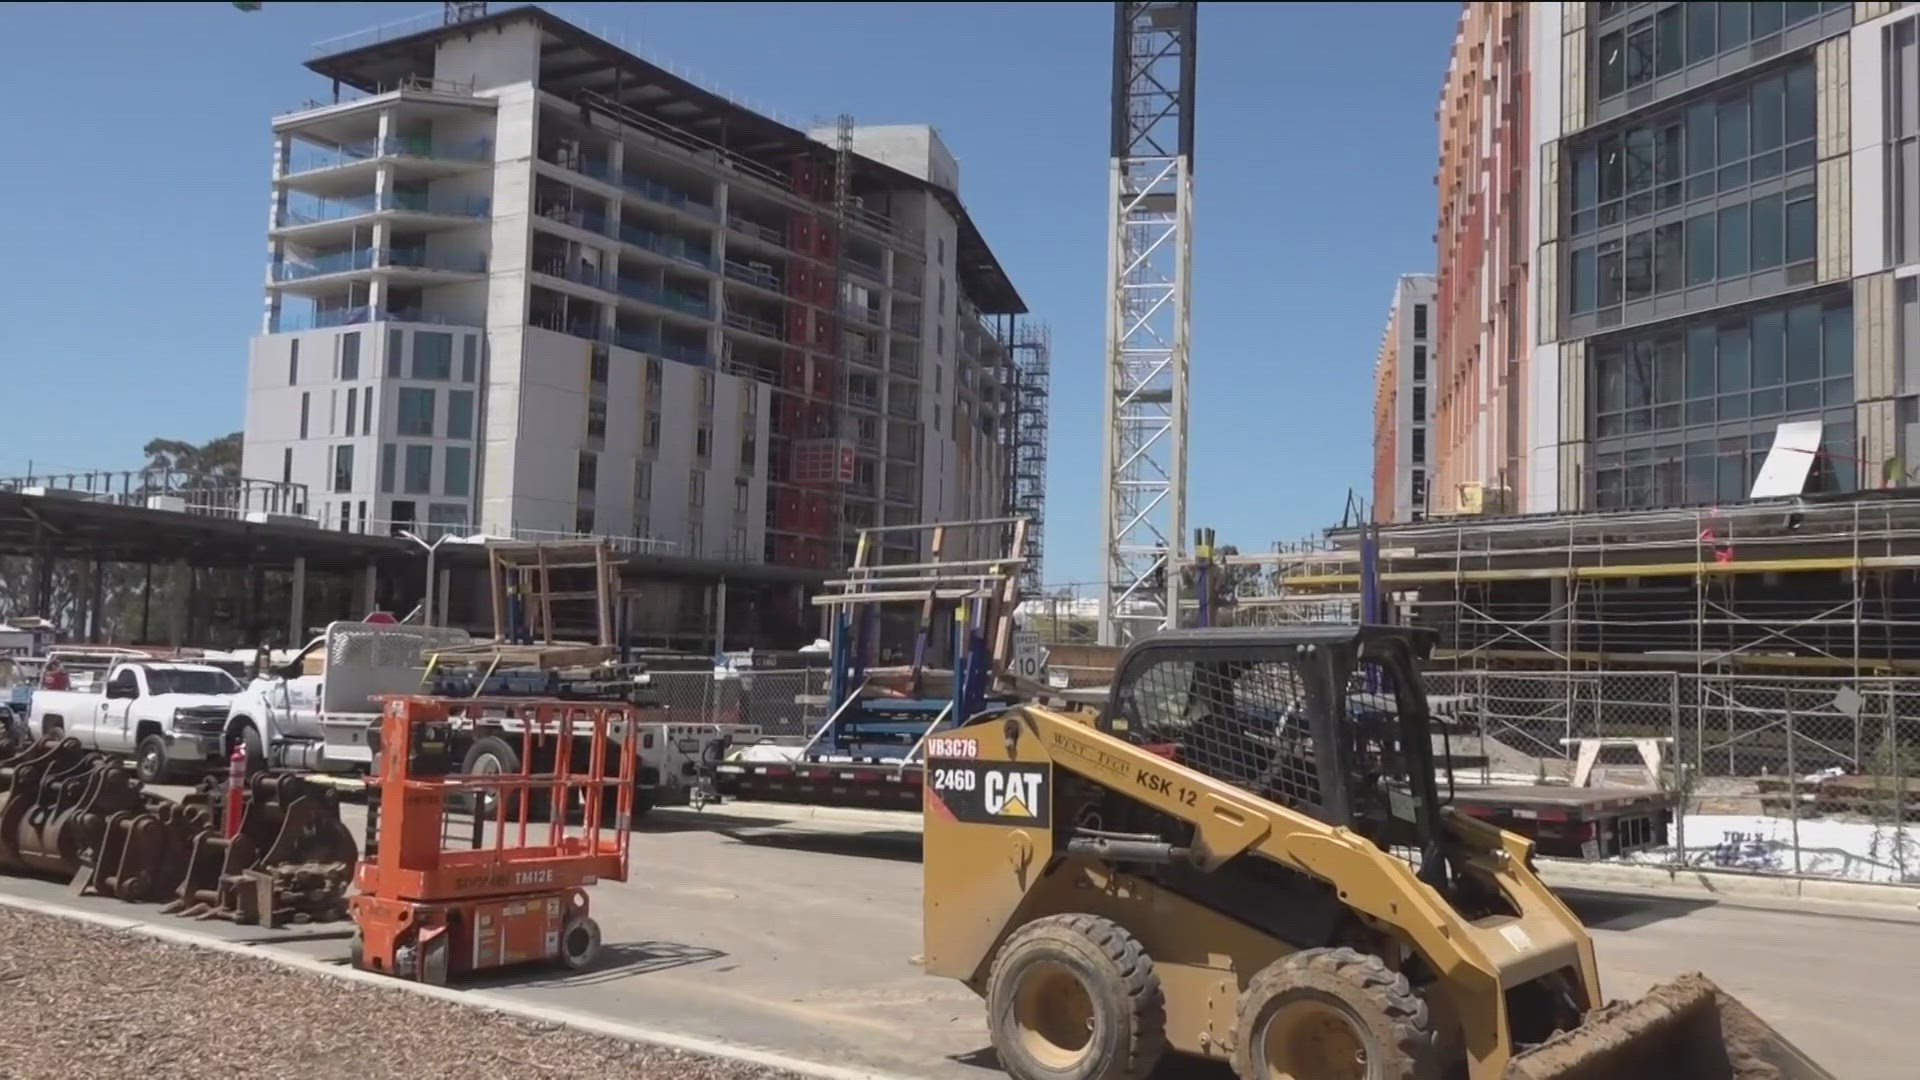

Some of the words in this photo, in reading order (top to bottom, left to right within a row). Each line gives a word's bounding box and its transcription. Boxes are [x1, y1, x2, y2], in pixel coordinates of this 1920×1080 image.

[1020, 657, 1036, 676] 10
[928, 738, 977, 758] VB3C76
[934, 768, 976, 791] 246D
[1136, 769, 1172, 797] KSK
[1179, 787, 1197, 808] 12
[984, 770, 1042, 818] CAT
[515, 868, 554, 885] TM12E
